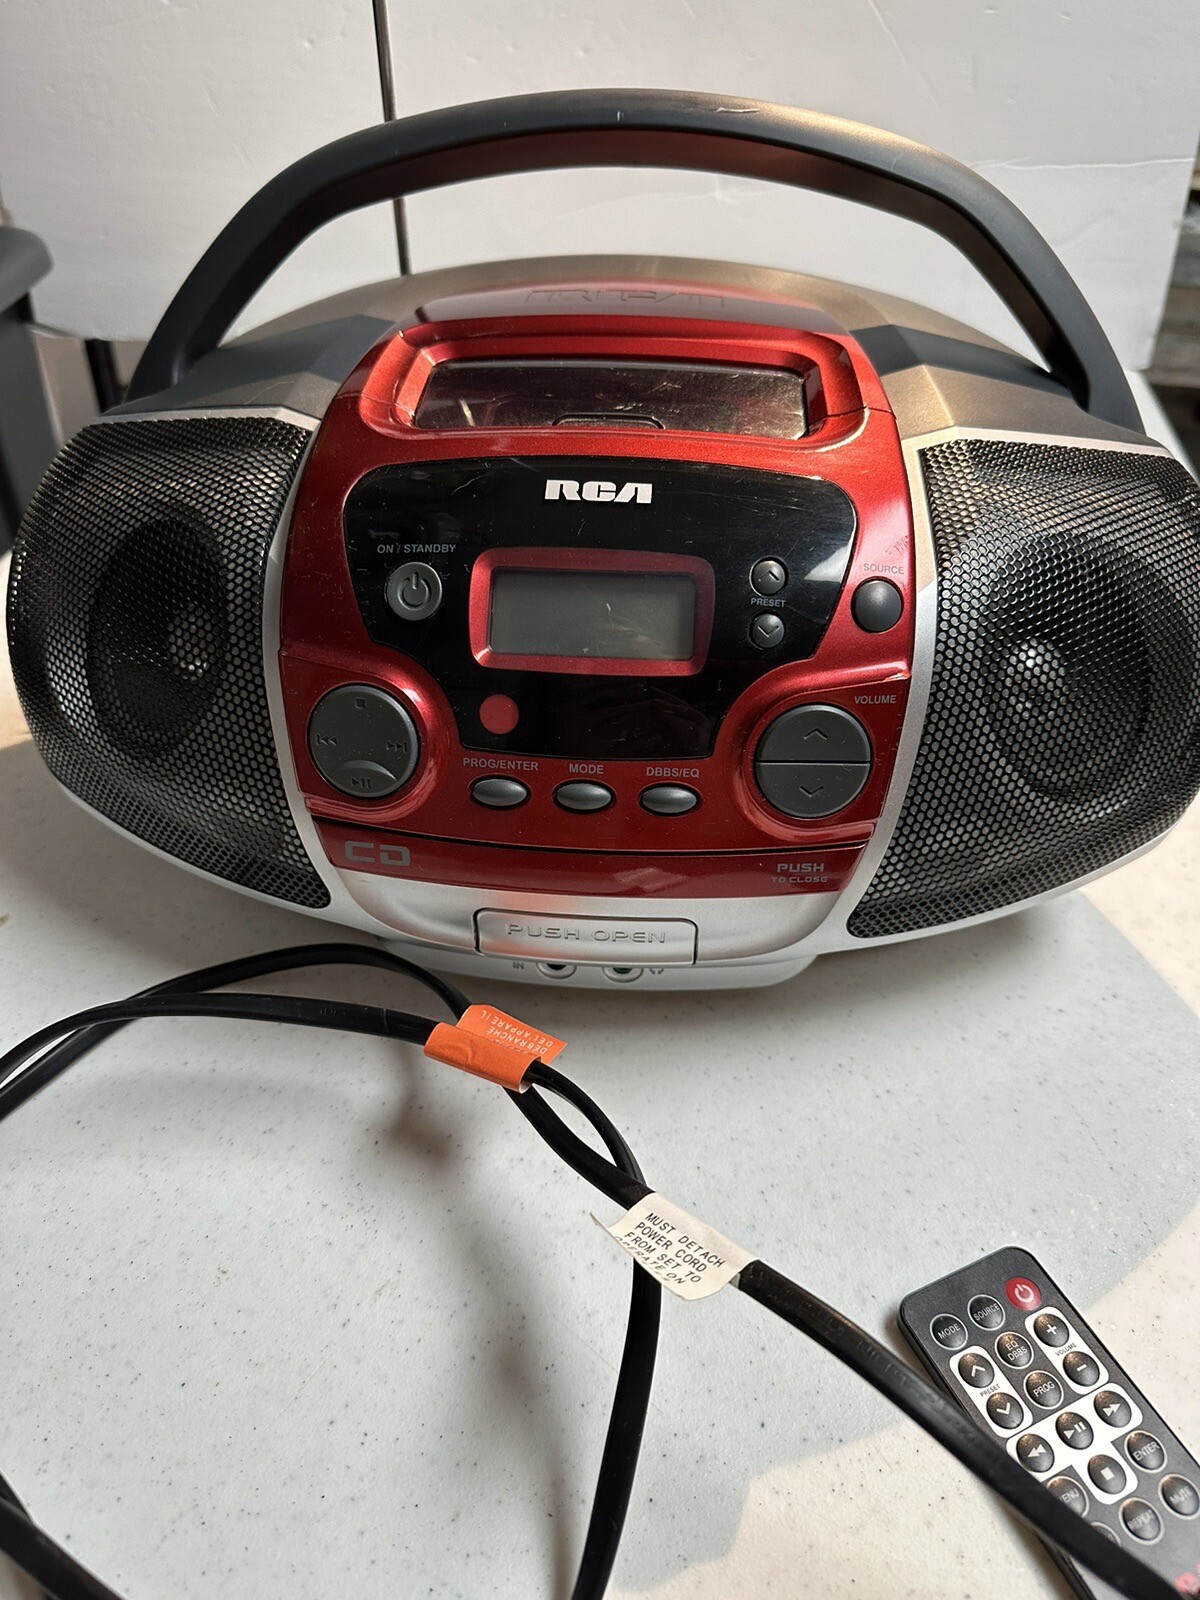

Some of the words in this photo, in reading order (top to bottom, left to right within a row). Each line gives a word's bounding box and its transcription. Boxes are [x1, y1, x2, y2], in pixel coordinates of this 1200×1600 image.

[544, 479, 653, 504] RCA
[377, 544, 394, 554] ON
[403, 543, 456, 554] STANDBY
[863, 563, 905, 575] SOURCE
[750, 597, 787, 608] PRESET
[854, 694, 897, 705] VOLUME
[462, 757, 539, 771] PROG/ENTER
[569, 763, 605, 775] MODE
[646, 766, 701, 779] DBBS/EQ
[344, 840, 411, 867] CD
[776, 863, 825, 873] PUSH
[771, 876, 787, 884] TO
[789, 875, 829, 883] CLOSE
[506, 924, 580, 941] PUSH
[591, 930, 666, 944] OPEN
[635, 1221, 673, 1250] POWER
[674, 1249, 707, 1273] CORD
[645, 1212, 677, 1234] MUST
[678, 1235, 726, 1268] DETACH
[624, 1231, 656, 1254] FROM
[657, 1253, 682, 1270] SET
[686, 1271, 701, 1283] TO
[666, 1271, 686, 1285] ON
[973, 1302, 1000, 1321] SOURCE
[937, 1323, 961, 1340] MODE
[1005, 1340, 1019, 1351] EQ
[1055, 1342, 1078, 1357] VOLUME
[1007, 1346, 1028, 1361] DBBS
[979, 1383, 1001, 1397] PRESET
[1032, 1381, 1056, 1397] PROG
[1132, 1441, 1161, 1461] ENTER
[1060, 1488, 1080, 1504] ENU
